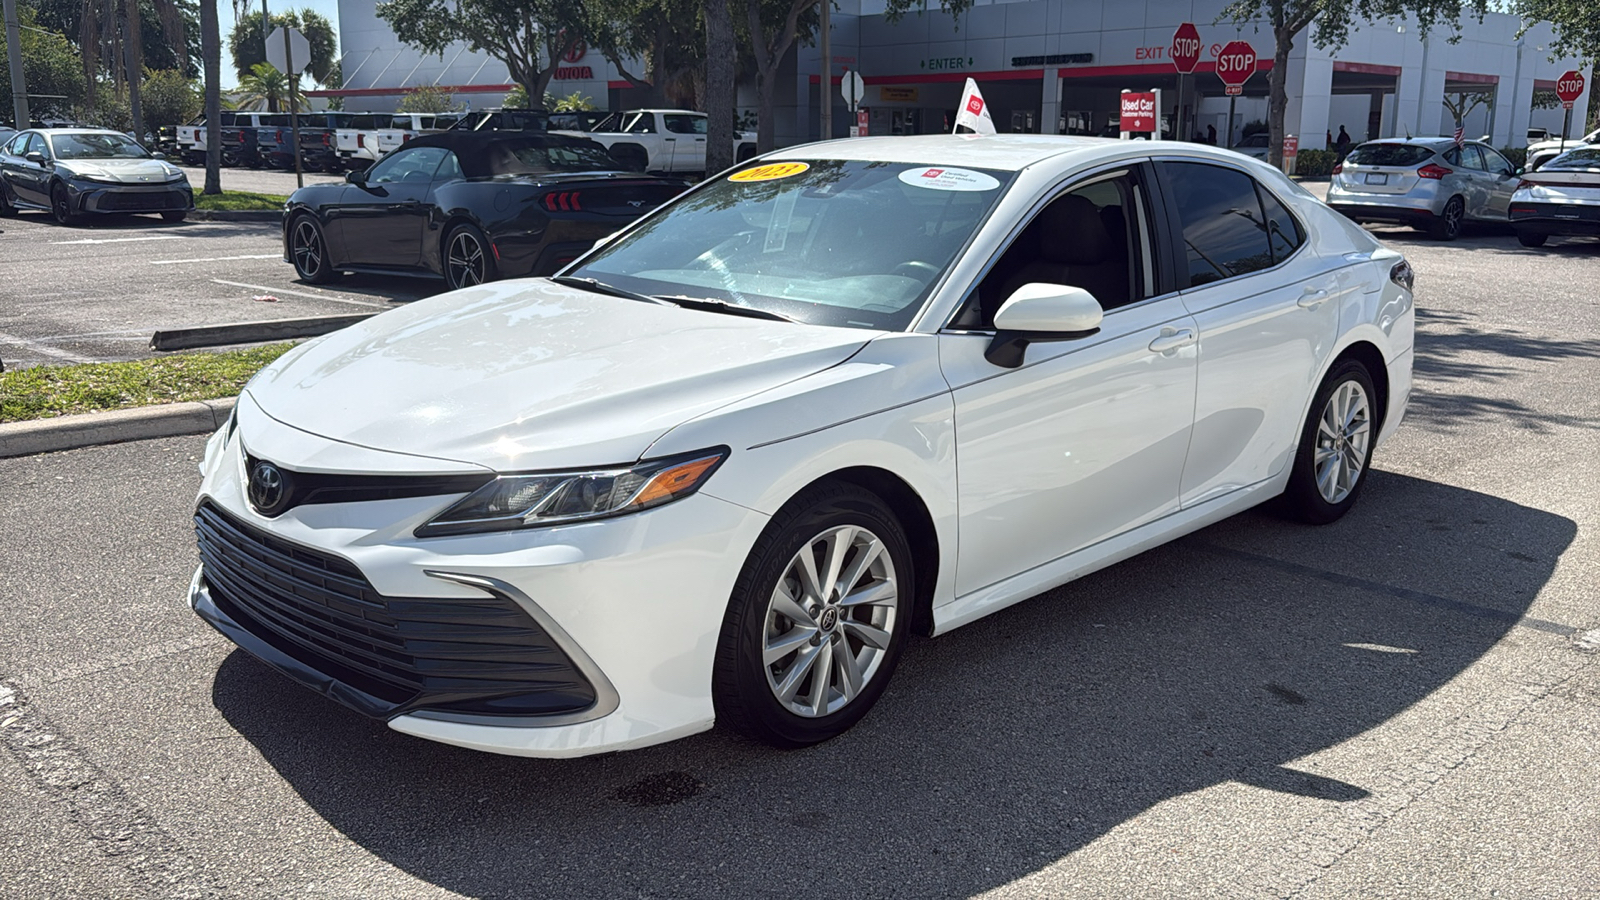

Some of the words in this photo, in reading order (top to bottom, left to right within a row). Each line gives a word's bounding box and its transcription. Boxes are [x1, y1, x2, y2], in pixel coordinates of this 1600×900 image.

[1135, 46, 1164, 60] EXIT
[1174, 38, 1199, 58] STOP
[929, 57, 964, 69] ENTER
[1219, 54, 1253, 71] STOP
[1558, 80, 1583, 93] STOP
[1121, 99, 1139, 110] Used
[1140, 99, 1154, 110] Car
[738, 164, 799, 178] 2023
